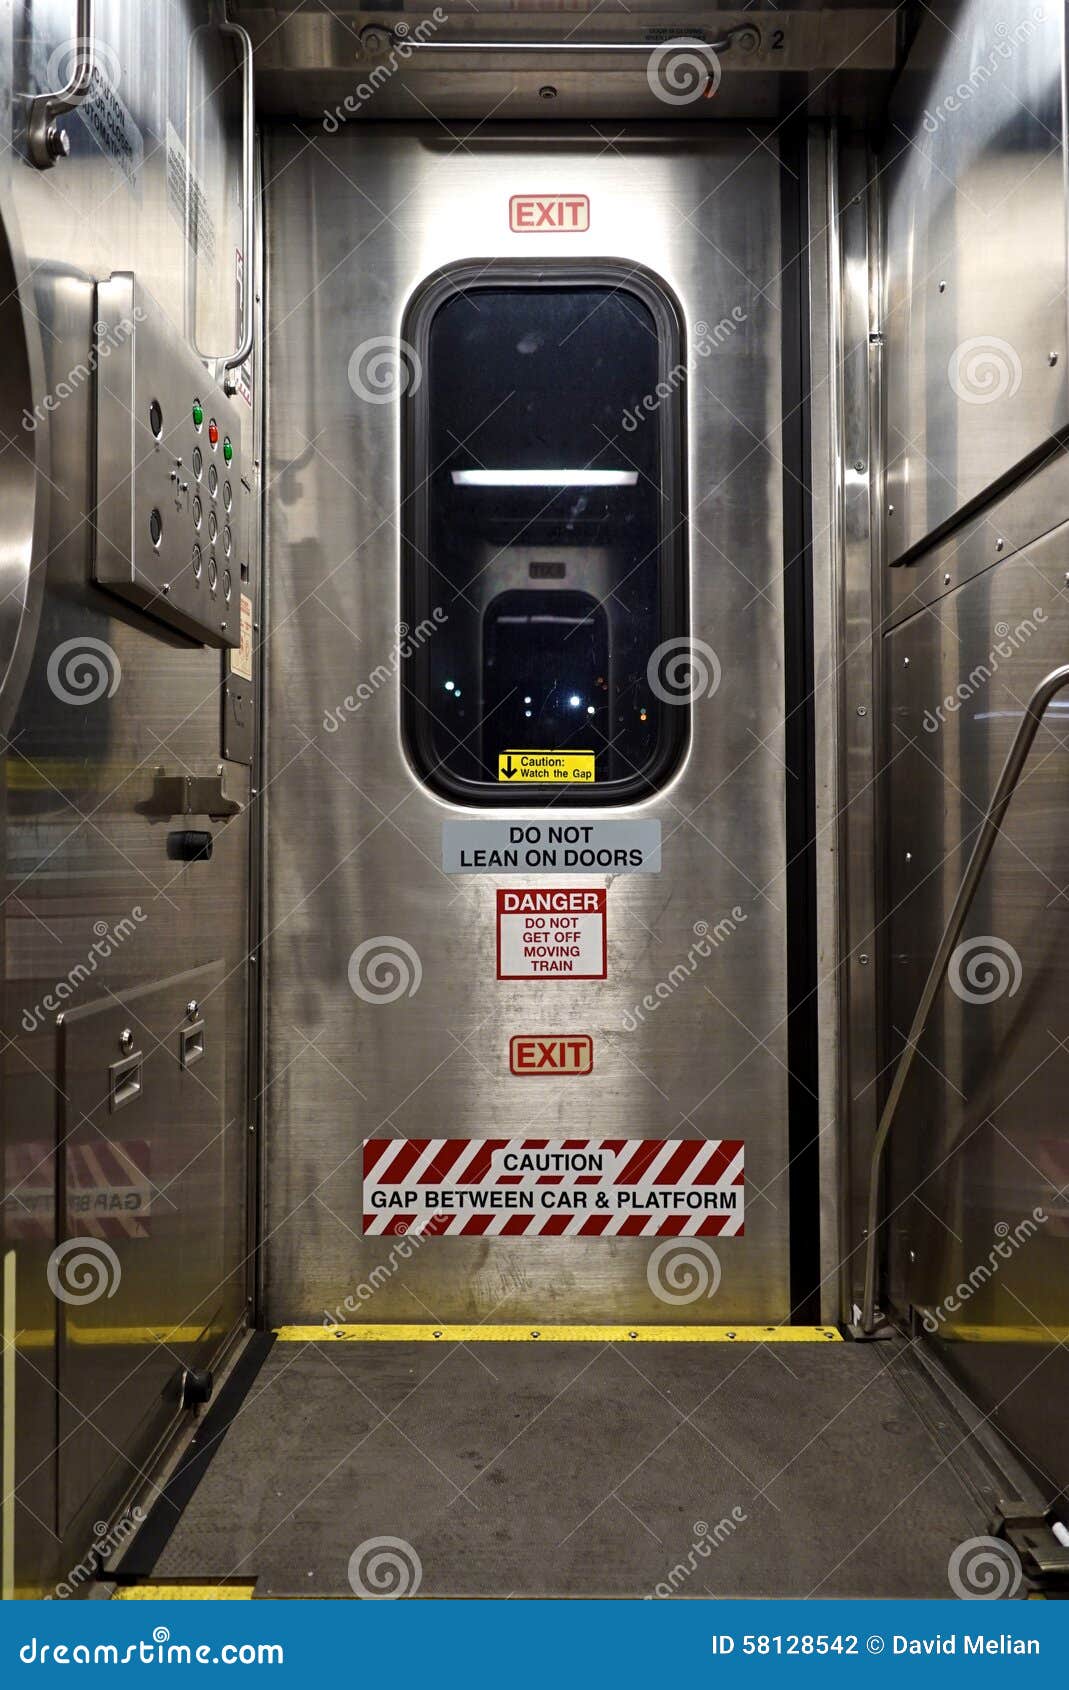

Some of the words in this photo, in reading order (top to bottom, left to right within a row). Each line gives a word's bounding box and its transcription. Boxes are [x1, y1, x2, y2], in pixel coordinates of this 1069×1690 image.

[771, 30, 785, 49] 2
[517, 201, 585, 226] EXIT
[520, 756, 565, 768] Caution:
[520, 767, 550, 779] Watch
[552, 767, 568, 779] the
[572, 767, 593, 781] Gap
[509, 826, 542, 844] DO
[548, 826, 594, 844] NOT
[460, 849, 518, 867] LEAN
[525, 849, 557, 867] ON
[564, 849, 643, 867] DOORS
[503, 892, 600, 911] DANGER
[525, 917, 545, 928] DO
[550, 917, 579, 928] NOT
[522, 931, 550, 943] GET
[554, 931, 581, 943] OFF
[523, 946, 580, 958] MOVING
[531, 960, 573, 972] TRAIN
[516, 1042, 587, 1068] EXIT
[503, 1153, 603, 1172] CAUTION
[370, 1190, 418, 1209] GAP
[425, 1190, 534, 1209] BETWEEN
[540, 1190, 587, 1209] CAR
[595, 1190, 610, 1209] &
[617, 1190, 737, 1209] PLATFORM
